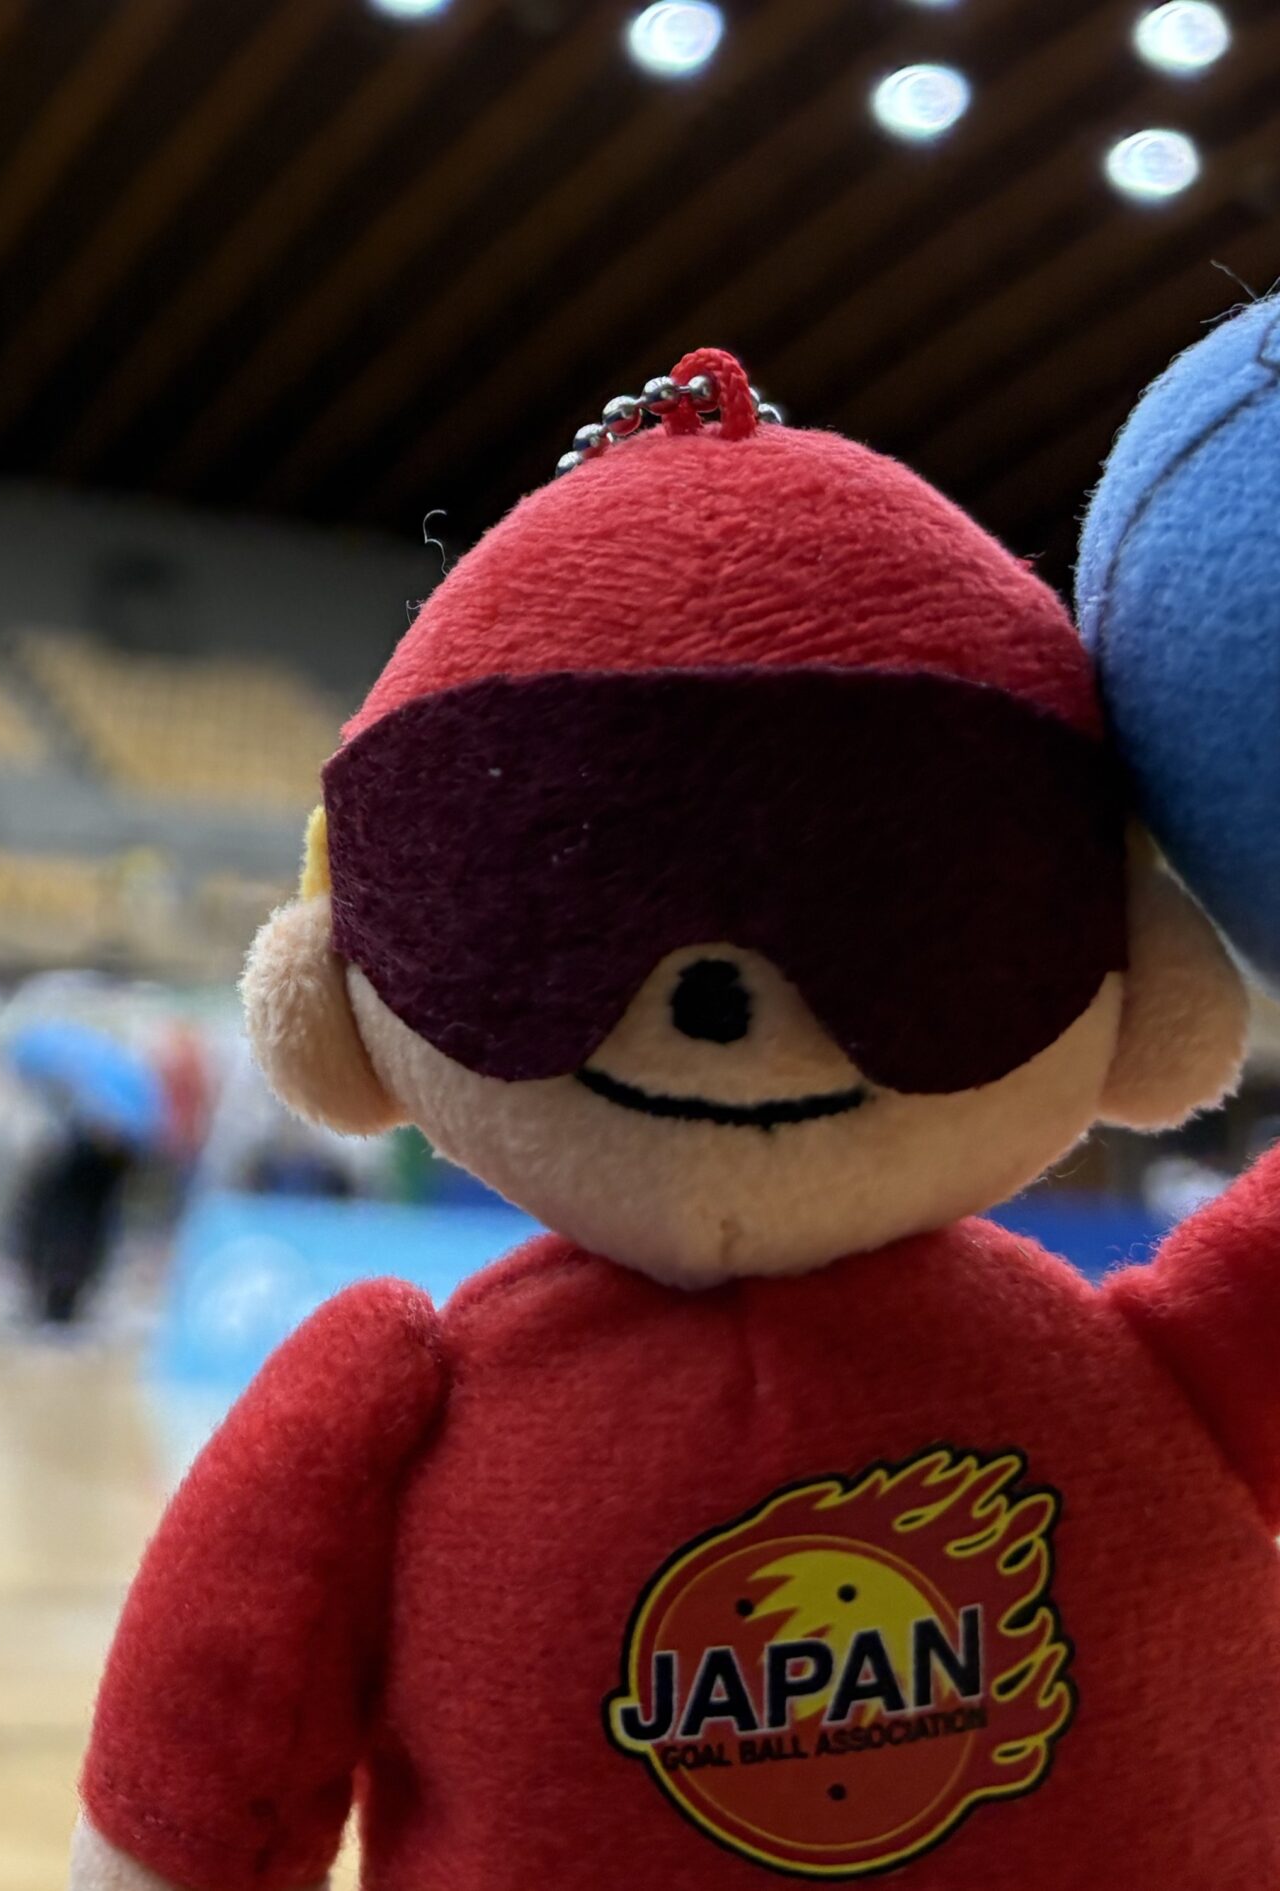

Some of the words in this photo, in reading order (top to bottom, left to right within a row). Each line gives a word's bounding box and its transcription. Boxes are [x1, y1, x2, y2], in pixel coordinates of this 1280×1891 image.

[618, 1604, 984, 1743] JAPAN
[662, 1741, 732, 1771] GOAL
[738, 1734, 808, 1765] BALL
[815, 1706, 988, 1757] ASSOCIATION
